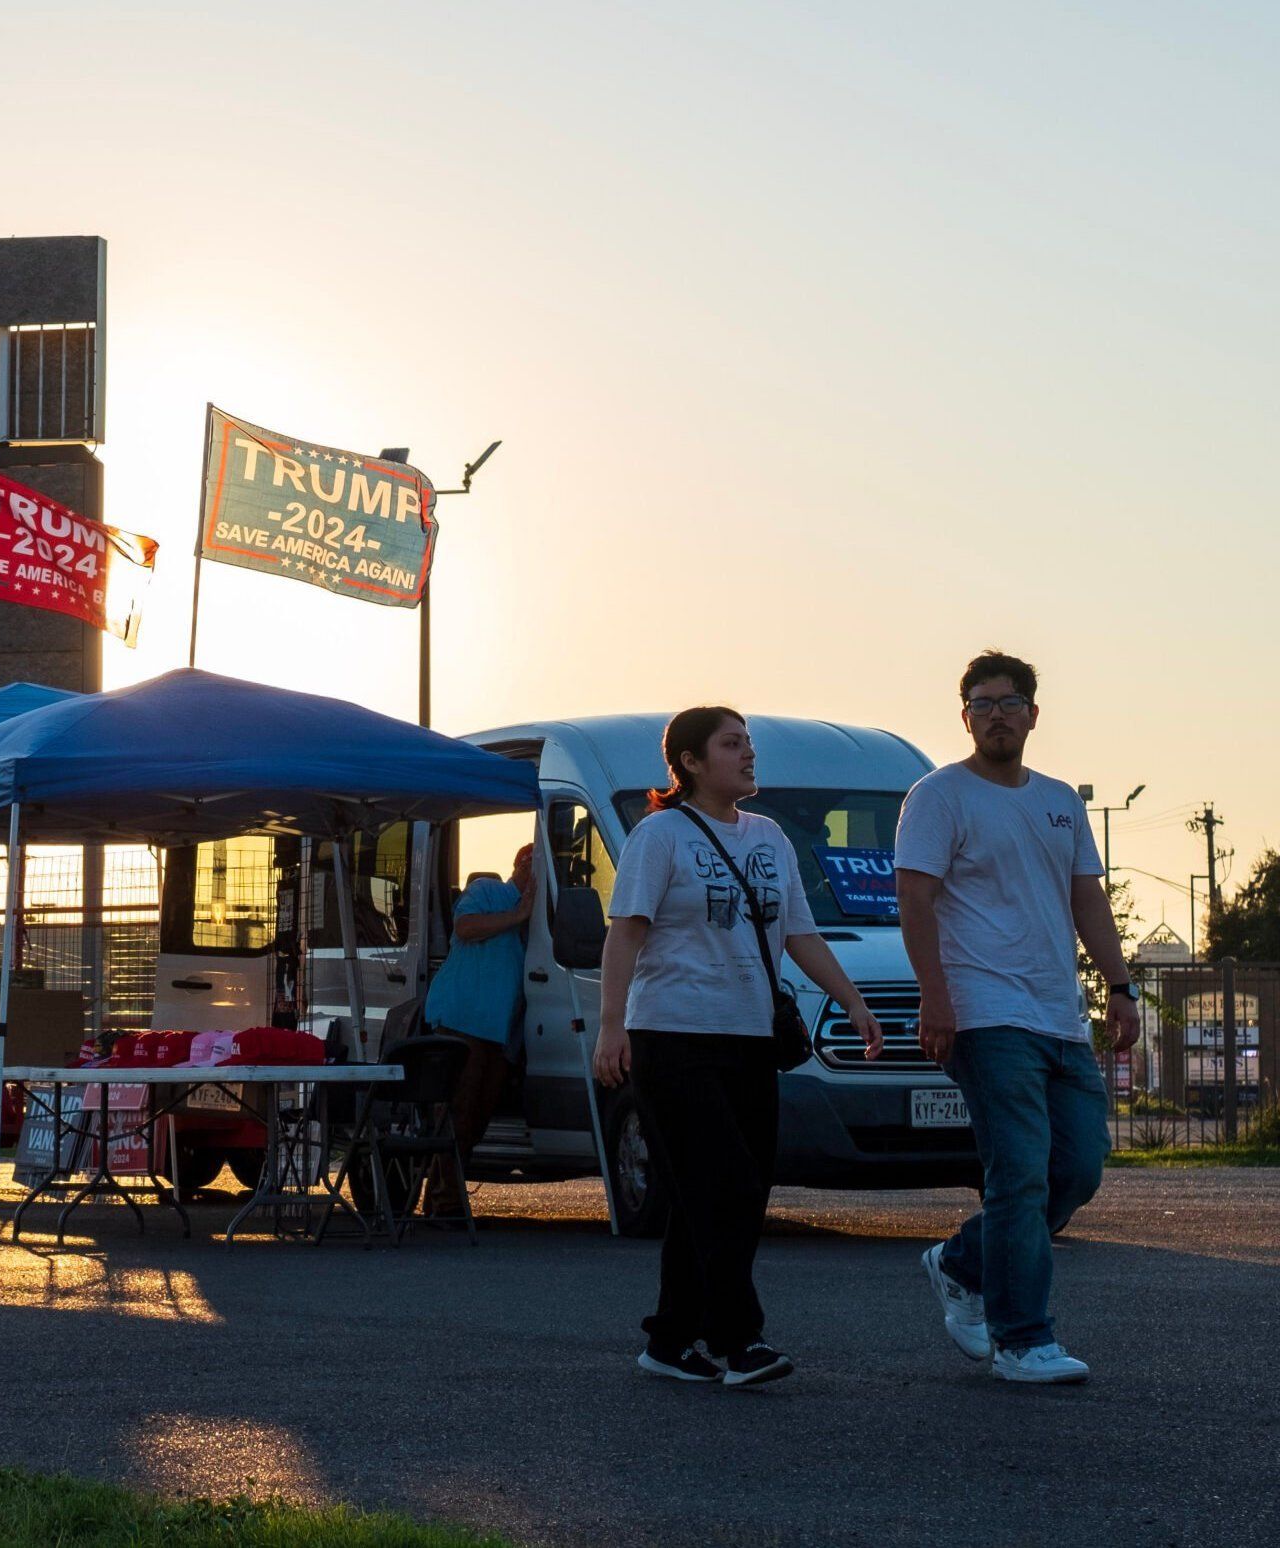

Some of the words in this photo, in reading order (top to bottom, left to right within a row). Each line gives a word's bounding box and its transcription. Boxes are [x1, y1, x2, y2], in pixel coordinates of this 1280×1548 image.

[235, 438, 421, 523] TRUMP
[268, 503, 381, 553] -2024-
[216, 522, 271, 547] SAVE
[271, 535, 351, 573] AMERICA
[354, 558, 416, 590] AGAIN!
[16, 563, 87, 598] AMERICA
[1046, 812, 1072, 829] Lee
[744, 852, 778, 880] ME
[826, 856, 894, 875] TRU
[847, 894, 874, 902] TAKE
